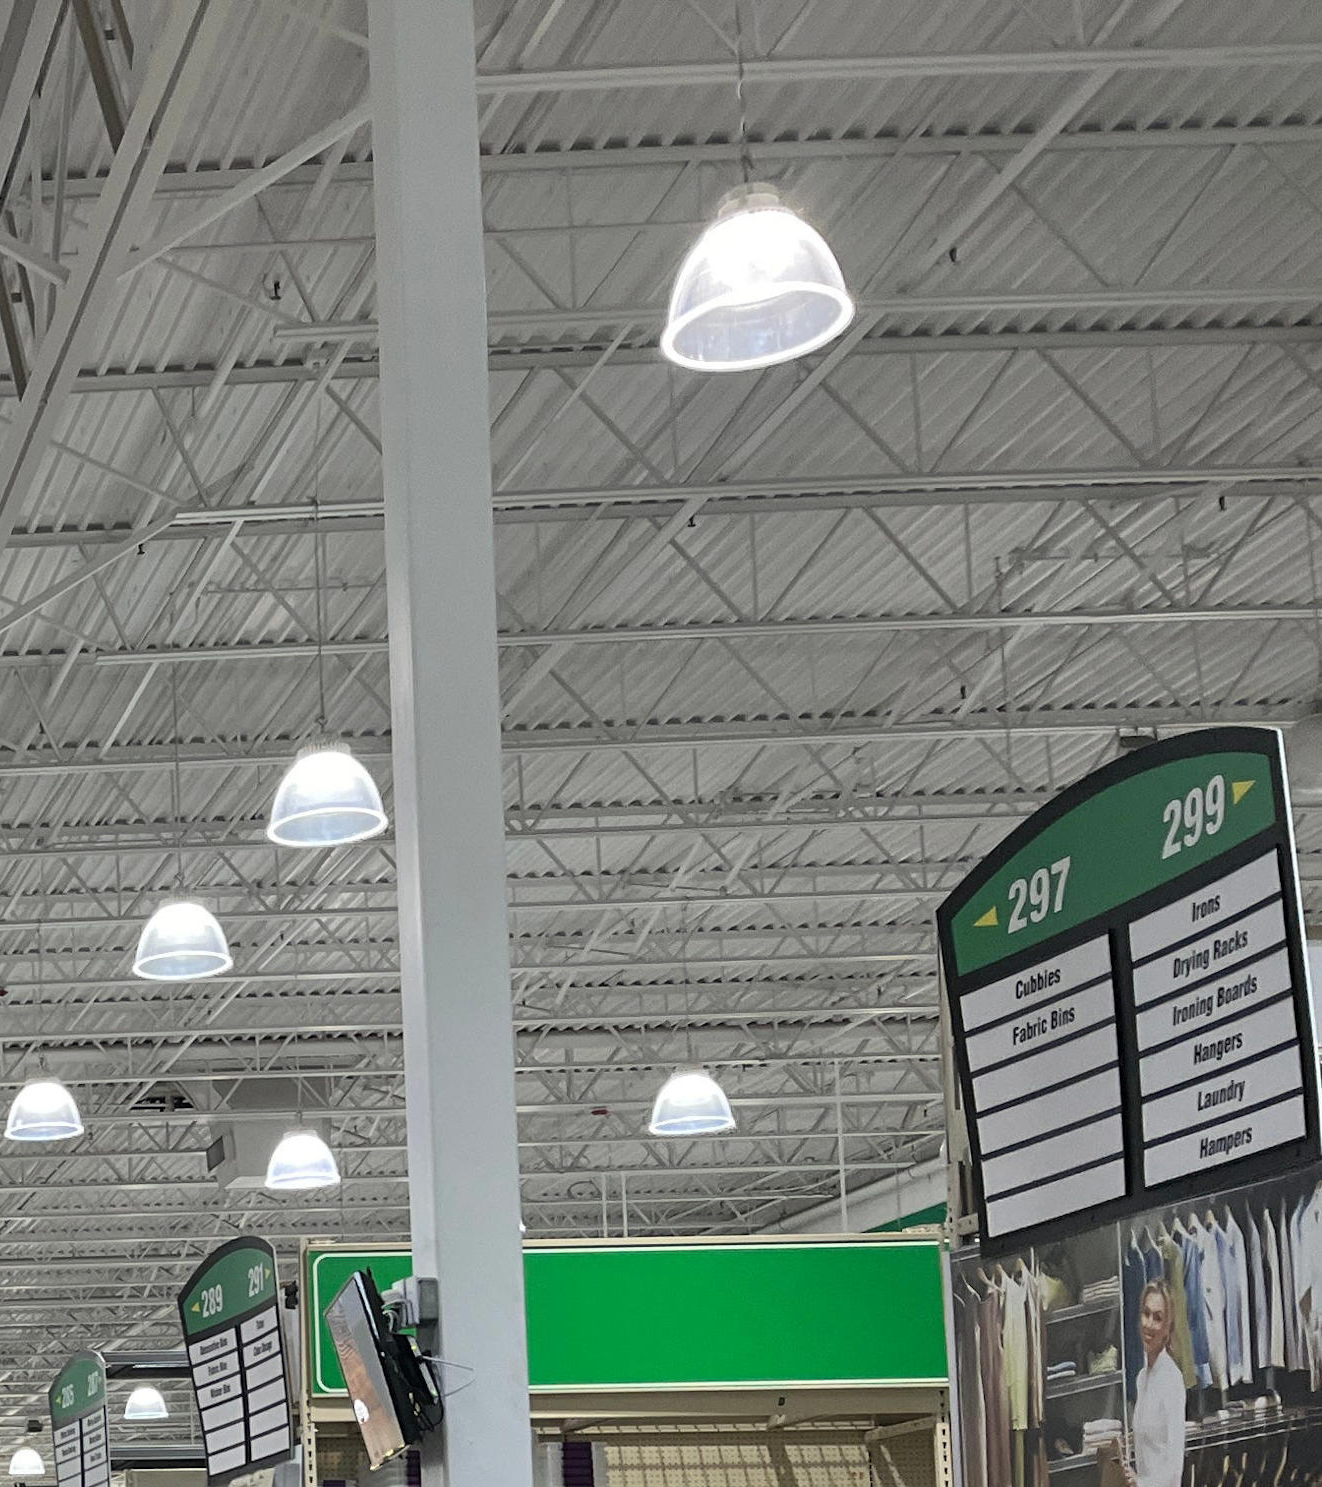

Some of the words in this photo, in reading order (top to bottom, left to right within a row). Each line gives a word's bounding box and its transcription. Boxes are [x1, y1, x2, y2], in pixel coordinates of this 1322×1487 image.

[1161, 774, 1226, 860] 299
[1007, 856, 1071, 934] 297
[1191, 895, 1221, 923] Irons
[1173, 945, 1209, 979] Drying
[1213, 929, 1248, 961] Racks
[1015, 967, 1061, 1000] Cubbies
[1172, 991, 1214, 1027] Ironing
[1216, 973, 1258, 1008] Boards
[1012, 1016, 1047, 1046] Fabric
[1050, 1005, 1075, 1030] Bins
[1193, 1031, 1243, 1064] Hangers
[1197, 1078, 1245, 1110] Laundry
[1199, 1126, 1253, 1158] Hampers
[248, 1262, 264, 1297] 291
[202, 1284, 223, 1318] 289
